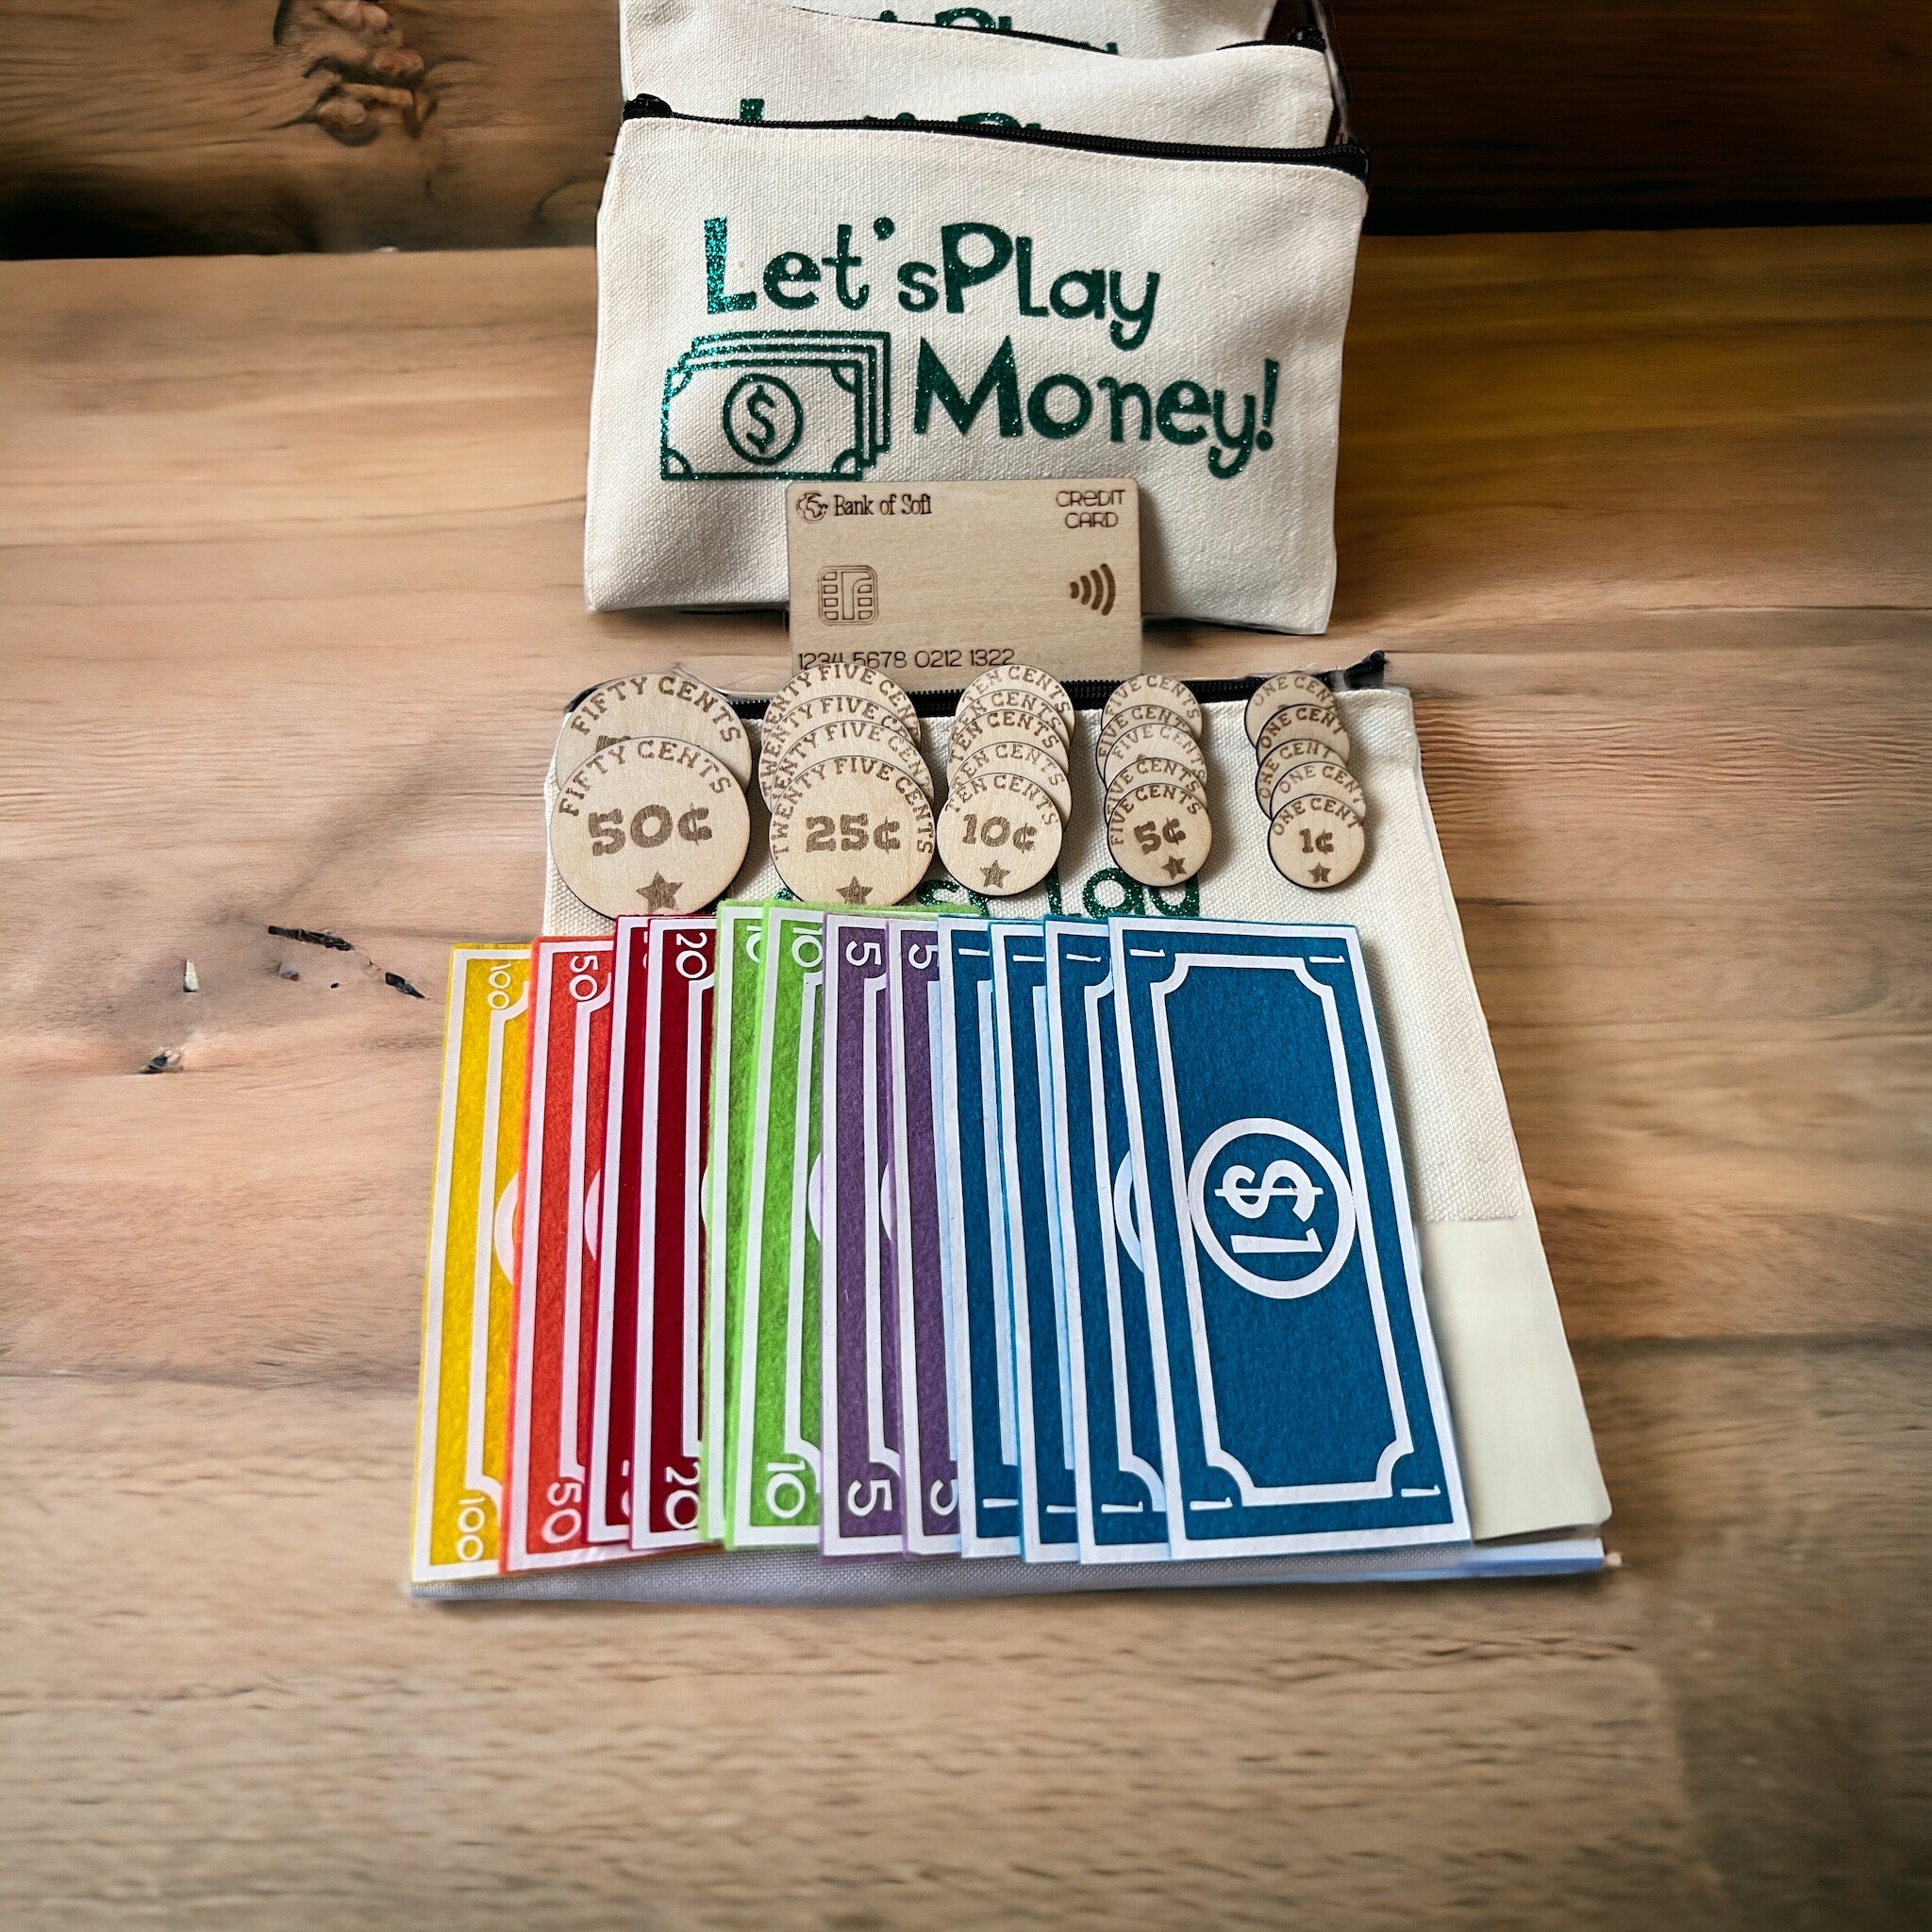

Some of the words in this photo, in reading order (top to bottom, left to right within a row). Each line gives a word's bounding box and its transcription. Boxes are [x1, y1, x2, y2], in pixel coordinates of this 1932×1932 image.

[703, 215, 939, 316] Let's
[912, 335, 1279, 480] Money!
[834, 494, 874, 517] Bank
[879, 494, 897, 516] of
[901, 493, 933, 516] Sofi
[1064, 511, 1119, 529] CARD
[852, 650, 908, 670] 5678
[914, 650, 963, 668] 0212
[971, 648, 1016, 667] 1322
[571, 676, 648, 735] FIFTY
[658, 675, 741, 742] CENTS
[763, 672, 812, 735] ENTY
[818, 663, 876, 685] FIVE
[820, 696, 879, 720] FIVE
[962, 670, 1003, 703] TEN
[1008, 666, 1072, 713] CENTS
[991, 691, 1061, 731] CENTS
[1106, 678, 1141, 716] FIVE
[1146, 675, 1200, 718] CENTS
[1254, 676, 1288, 707] ONE
[1293, 676, 1338, 712] CENT
[949, 721, 983, 763] TEN
[987, 711, 1059, 749] CENTS
[1098, 714, 1129, 758] FIVE
[1132, 707, 1190, 734] CENT
[1111, 724, 1154, 759] FIVE
[1260, 712, 1291, 749] ONE
[1295, 708, 1347, 735] CENT
[558, 745, 625, 817] FIFTY
[637, 740, 731, 794] CENTS
[772, 732, 817, 799] ENTY
[824, 722, 883, 741] FIVE
[952, 750, 990, 791] TEN
[995, 743, 1066, 786] CENTS
[1259, 758, 1279, 799] ONE
[1279, 742, 1335, 760] CENT
[944, 777, 988, 813] TEN
[993, 774, 1059, 825] CENTS
[1108, 770, 1134, 814] FIVE
[1136, 759, 1200, 792] CENTS
[1278, 765, 1316, 794] ONE
[1322, 765, 1365, 804] CENT
[588, 802, 713, 857] 50¢
[771, 764, 825, 860] TWENTY
[834, 758, 895, 782] FIVE
[895, 775, 935, 855] CENTS
[1110, 798, 1135, 845] FIVE
[1135, 784, 1202, 815] CENTS
[1272, 800, 1306, 836] ONE
[1309, 797, 1362, 829] CENT
[806, 812, 901, 854] 25¢
[962, 813, 1038, 854] 10¢
[1133, 817, 1187, 856] 5¢
[1299, 828, 1335, 855] 1¢
[675, 931, 708, 979] 20
[791, 926, 823, 968] 10
[844, 940, 882, 966] 5
[908, 943, 939, 970] 5
[1129, 948, 1166, 958] 1
[1308, 955, 1345, 963] 1
[487, 963, 512, 1010] 100
[568, 955, 600, 1002] 50
[1214, 1159, 1324, 1254] $1
[663, 1461, 700, 1530] 20
[765, 1459, 807, 1519] 10
[847, 1478, 893, 1517] 5
[1101, 1501, 1144, 1513] 1
[1190, 1496, 1234, 1511] 1
[1401, 1484, 1441, 1498] 1
[456, 1497, 487, 1563] 100
[541, 1481, 583, 1544] 50
